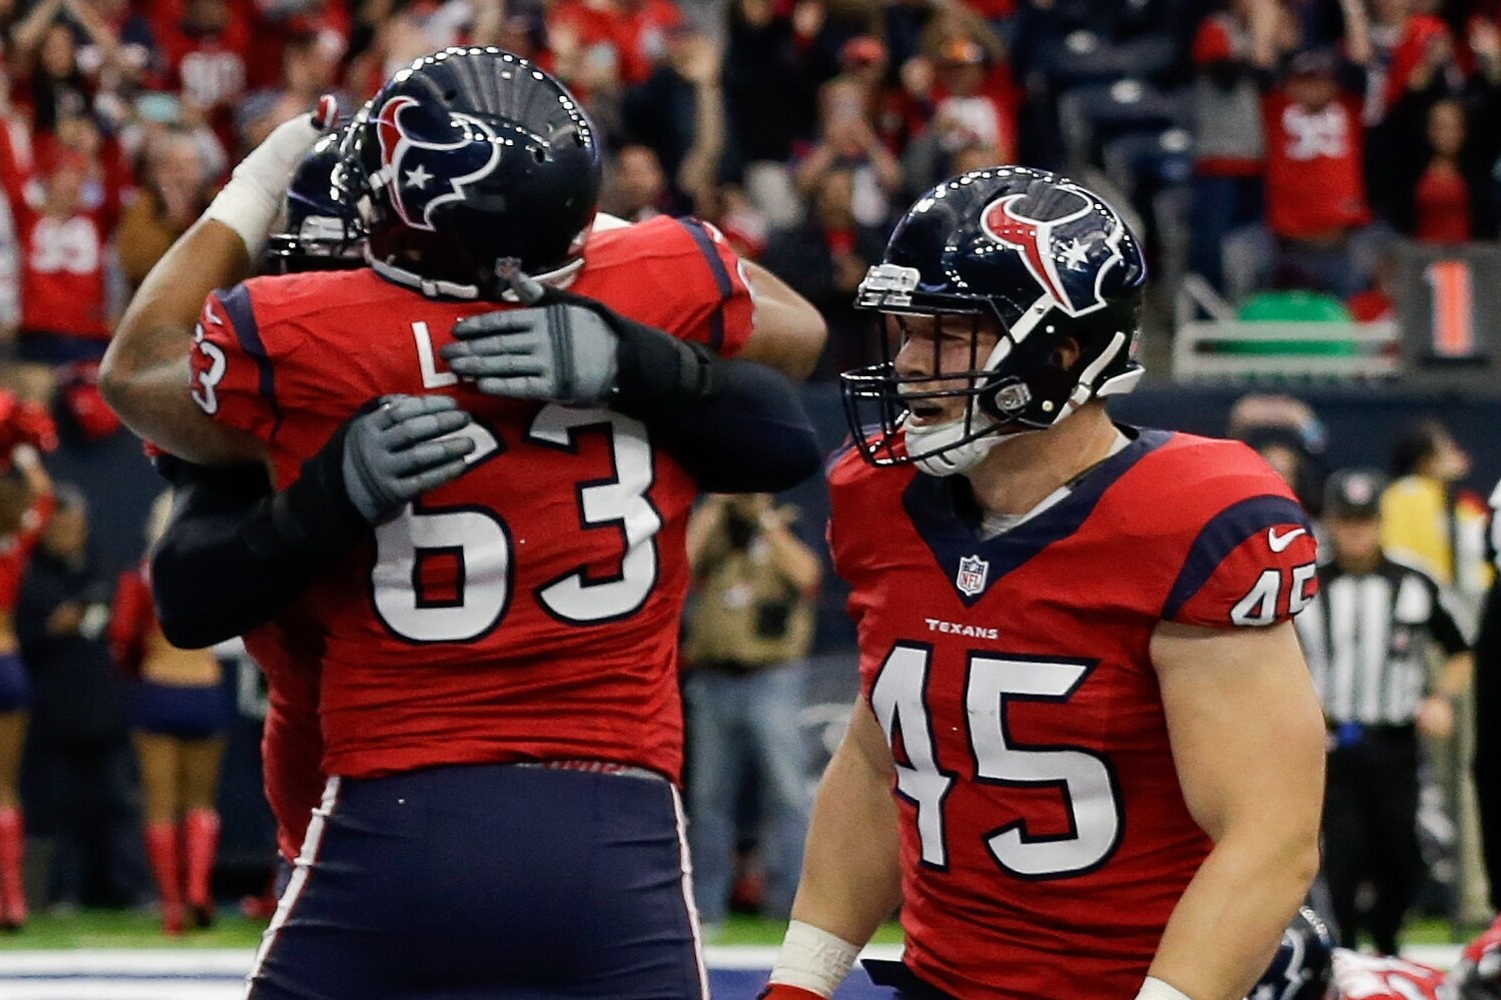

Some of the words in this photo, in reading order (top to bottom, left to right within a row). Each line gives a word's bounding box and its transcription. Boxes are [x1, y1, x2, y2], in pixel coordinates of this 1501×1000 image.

[371, 403, 662, 645] 63
[924, 617, 999, 640] TEXANS
[869, 641, 1125, 881] 45
